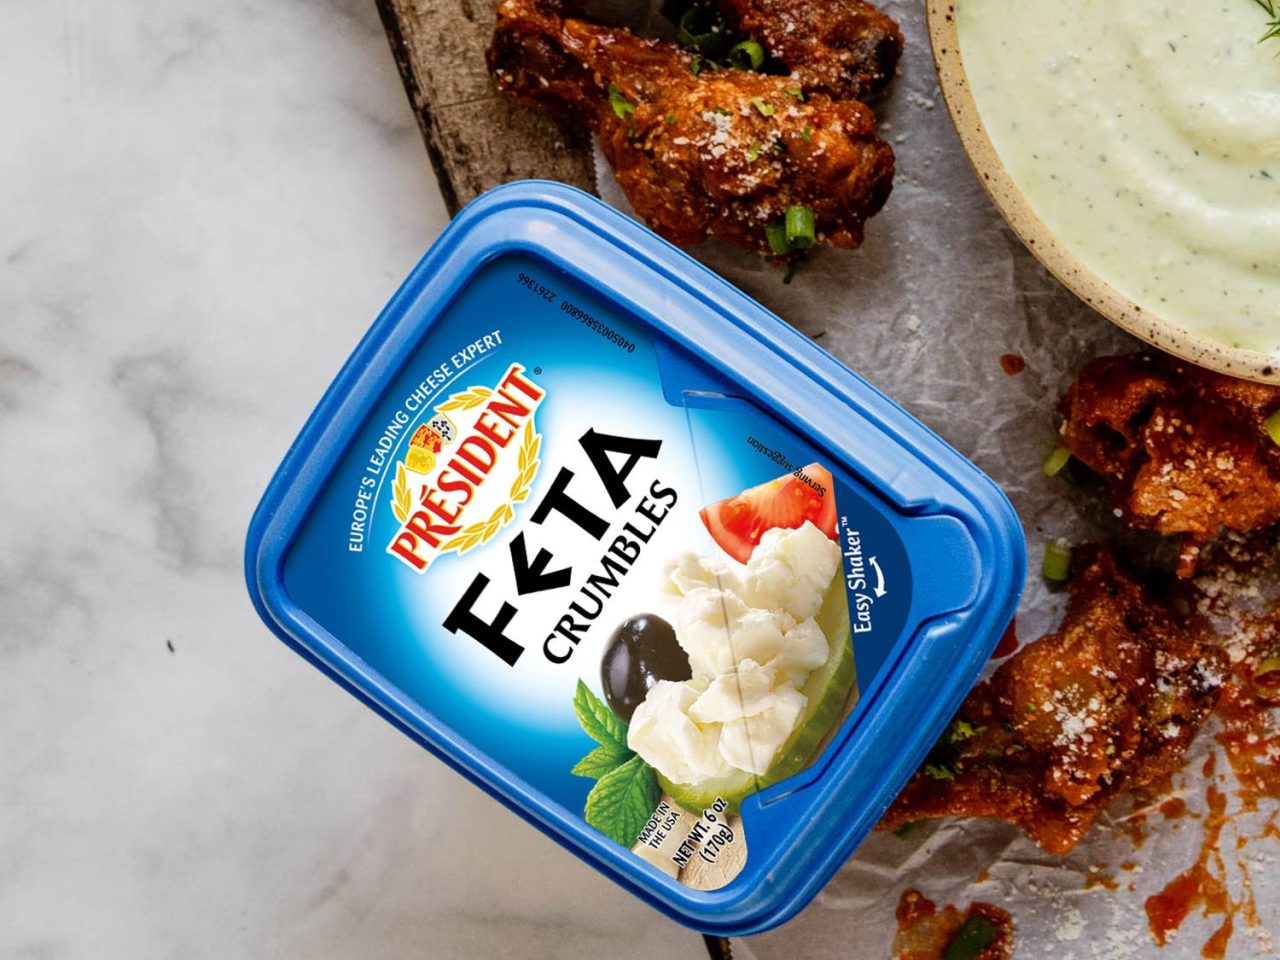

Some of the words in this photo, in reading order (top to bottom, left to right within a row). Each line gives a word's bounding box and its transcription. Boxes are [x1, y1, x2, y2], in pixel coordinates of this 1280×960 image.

[349, 466, 376, 552] EUROPE'S
[369, 410, 410, 475] LEADING
[405, 363, 453, 411] CHEESE
[451, 330, 504, 369] EXPERT
[746, 435, 794, 472] suggestion
[793, 466, 827, 498] Serving
[442, 426, 663, 668] FETA
[542, 478, 679, 665] CRUMBLES
[854, 592, 874, 634] Easy
[638, 814, 662, 844] MADE
[657, 802, 671, 816] IN
[649, 829, 667, 849] THE
[662, 811, 681, 831] USA
[672, 840, 696, 867] NET
[688, 821, 711, 843] WT.
[704, 810, 717, 823] 6
[699, 823, 734, 864] (170g)
